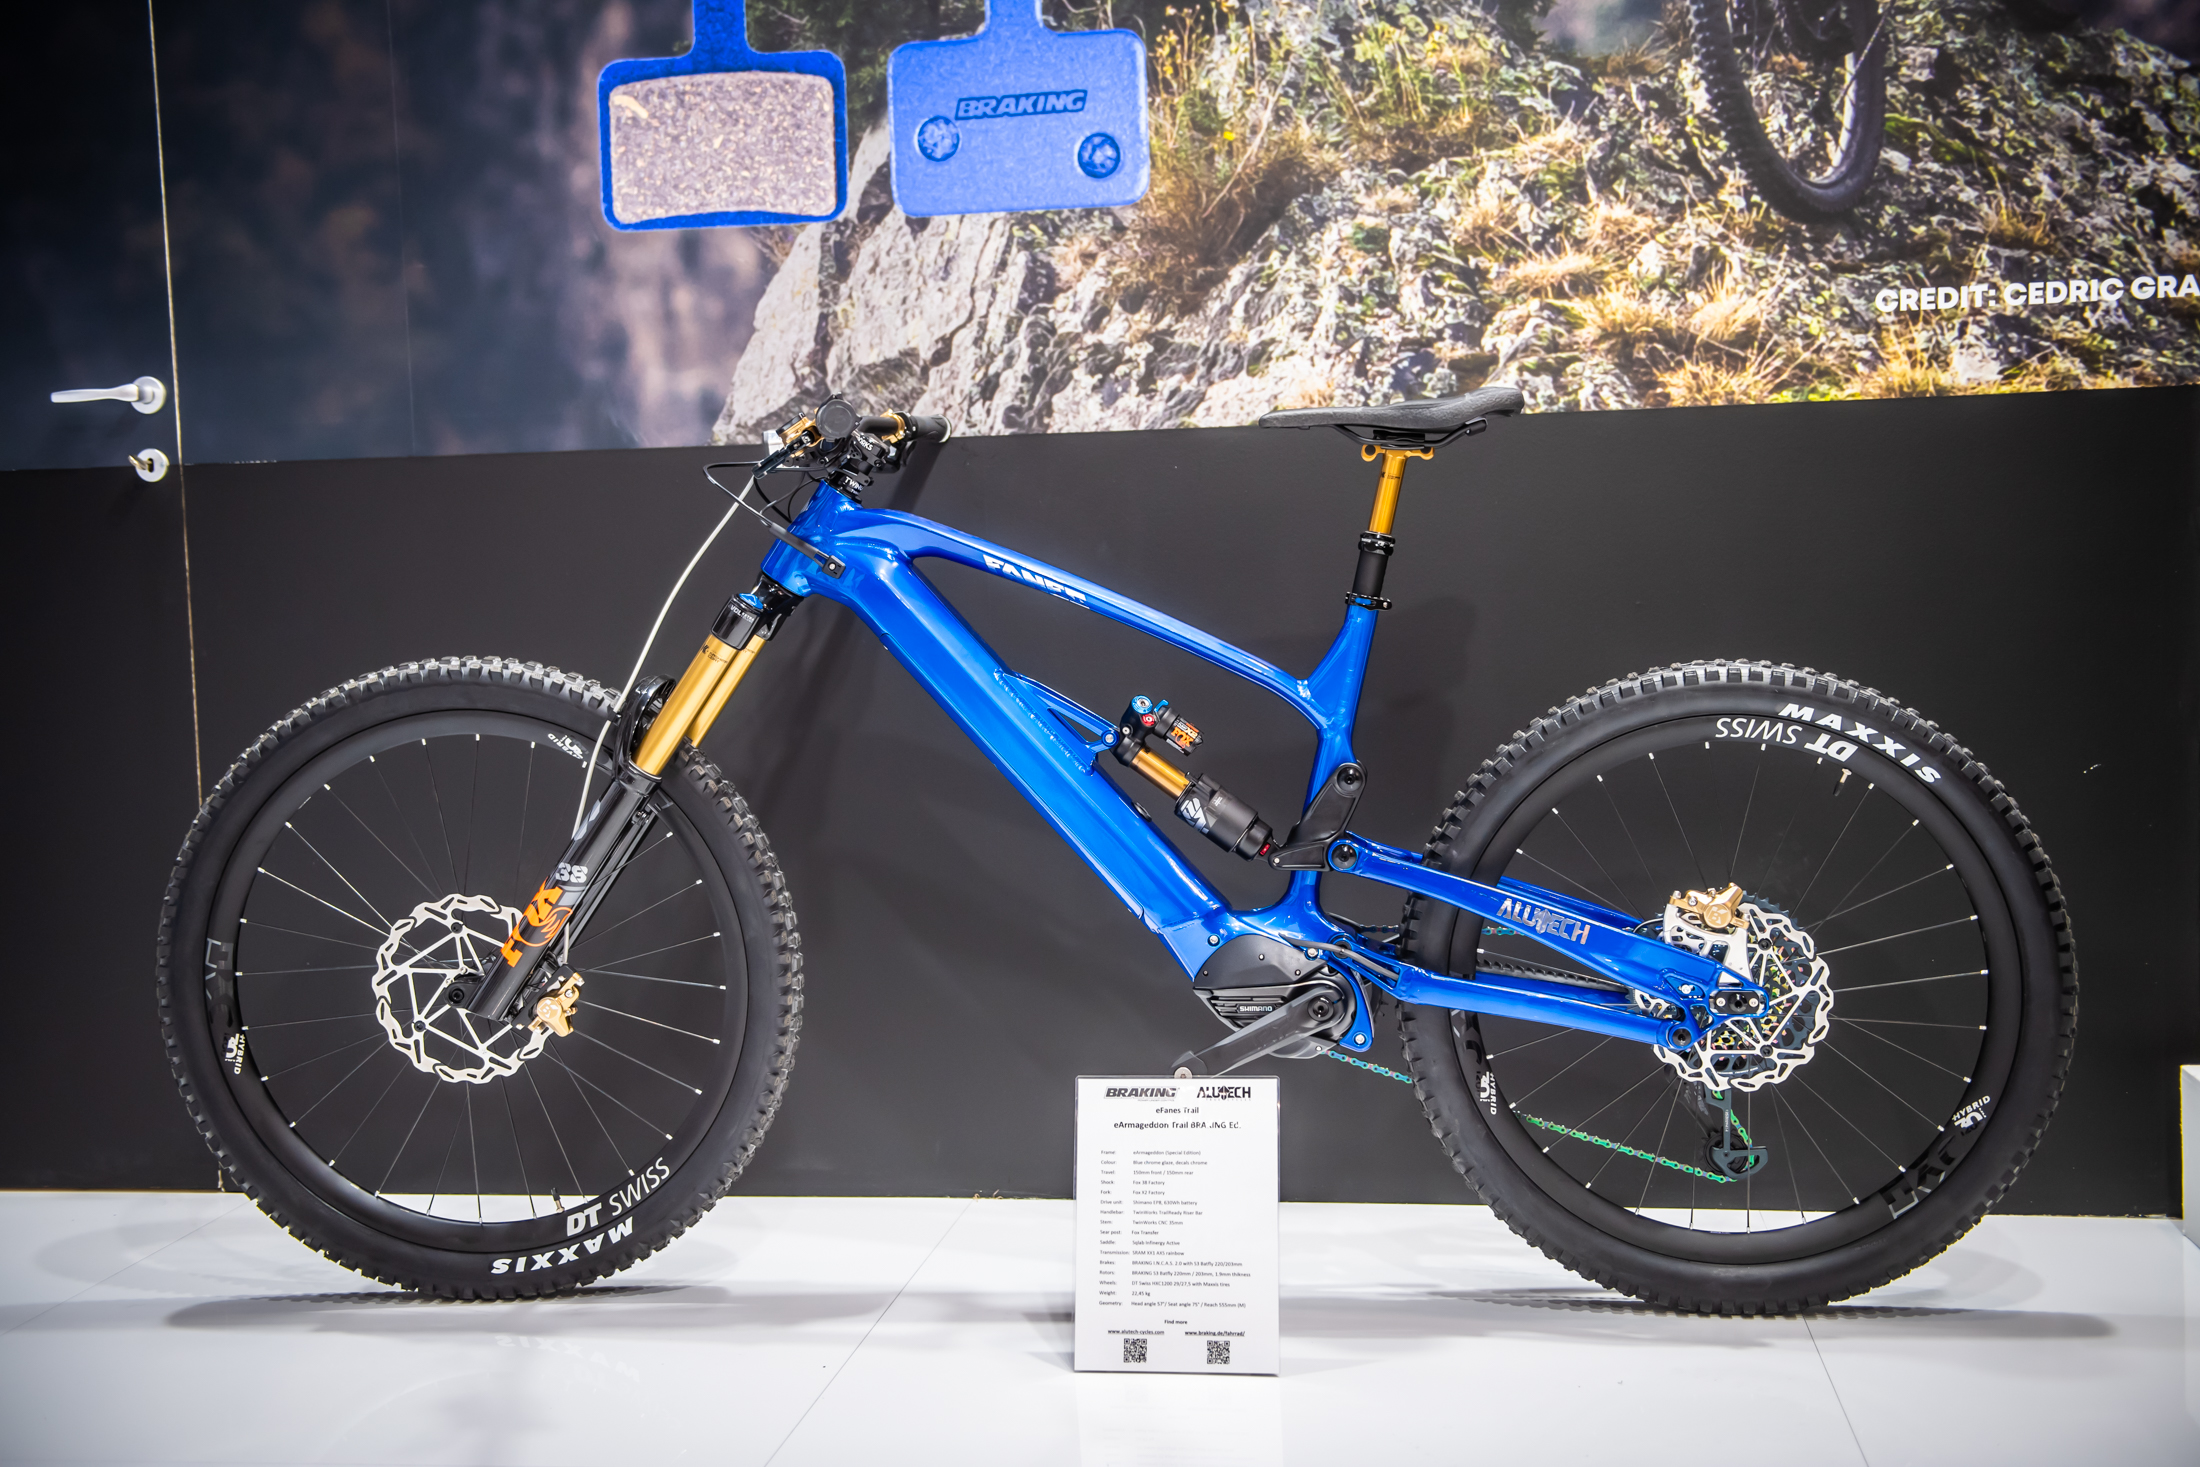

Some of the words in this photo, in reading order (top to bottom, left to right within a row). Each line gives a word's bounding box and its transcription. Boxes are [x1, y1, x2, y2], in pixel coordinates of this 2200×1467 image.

[956, 91, 1086, 119] BRAKING
[1875, 283, 1996, 313] CREDIT:
[2003, 277, 2124, 307] CEDRIC
[1171, 726, 1194, 749] FOX
[1715, 717, 1803, 745] SWISS
[1778, 702, 1941, 784] MAXXIS
[1803, 733, 1859, 762] DT
[1496, 897, 1591, 945] ALUTECH
[234, 1034, 246, 1075] HYBRID
[1105, 1087, 1177, 1098] BRAKING
[1196, 1086, 1251, 1099] ALUTECH
[1489, 1072, 1497, 1116] HYBRID
[1951, 1095, 1991, 1122] HYBRID
[1113, 1121, 1169, 1130] eArmageddon
[1172, 1121, 1188, 1129] Trail
[1190, 1121, 1227, 1129] BRAING
[567, 1202, 602, 1237] DT
[608, 1157, 671, 1216] SWISS
[490, 1216, 633, 1275] MAXXIS
